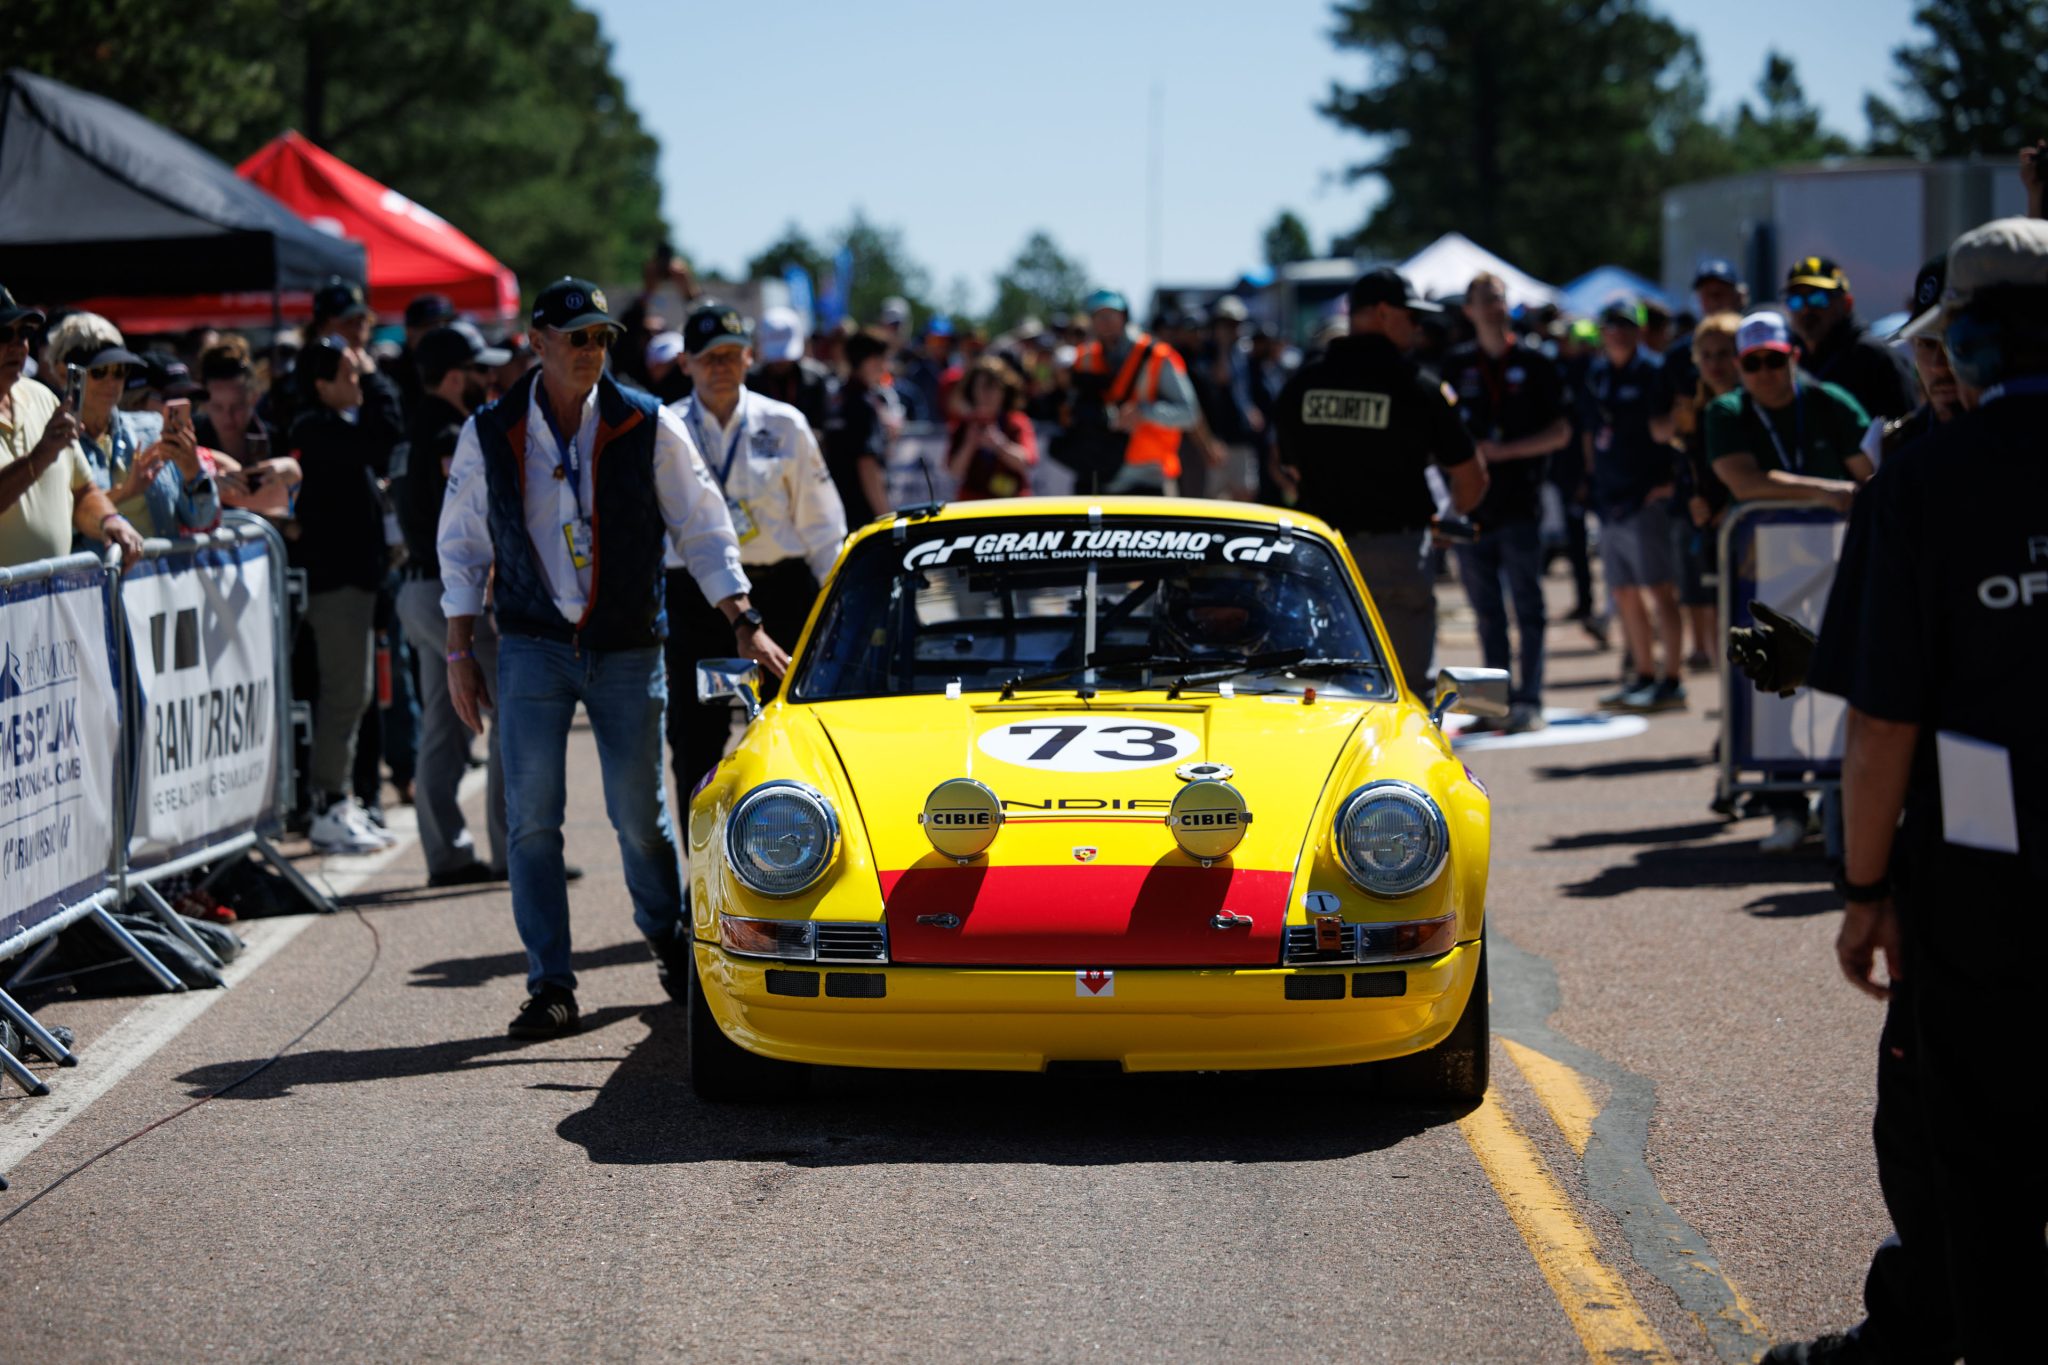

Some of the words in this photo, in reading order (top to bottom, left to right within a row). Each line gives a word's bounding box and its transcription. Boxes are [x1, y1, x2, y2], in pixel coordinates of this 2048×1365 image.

[1307, 394, 1384, 422] SECURITY
[973, 531, 1065, 555] GRAN
[975, 552, 1005, 563] THE
[1009, 551, 1049, 561] REAL
[1051, 549, 1113, 560] DRIVING
[1117, 549, 1206, 561] SIMULATOR
[1008, 725, 1178, 762] 73
[1307, 893, 1335, 912] T
